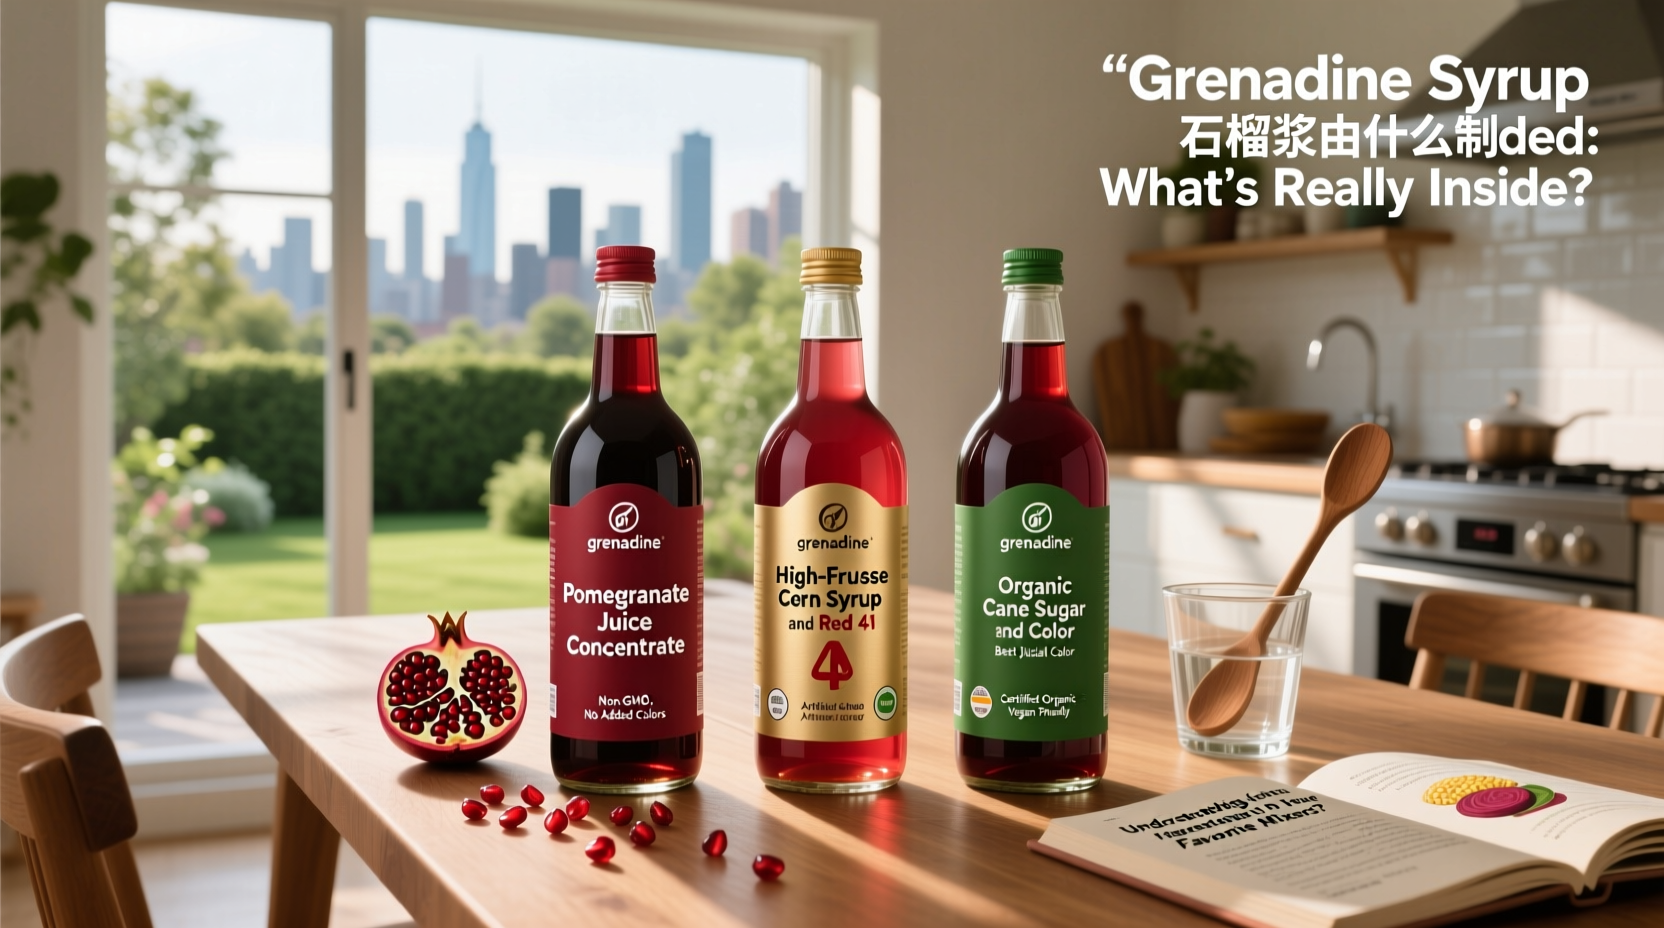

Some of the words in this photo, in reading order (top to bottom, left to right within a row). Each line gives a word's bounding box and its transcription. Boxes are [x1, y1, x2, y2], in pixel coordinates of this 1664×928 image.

[587, 534, 661, 553] grenadine
[797, 534, 870, 552] grenadine
[1000, 534, 1072, 553] grenadine
[776, 565, 889, 590] High-Frusse
[998, 575, 1073, 601] Organic
[563, 582, 690, 610] Pomegranate
[826, 589, 882, 613] Syrup
[982, 597, 1030, 618] Cane
[1034, 599, 1086, 622] Sugar
[597, 611, 653, 632] Juice
[788, 615, 814, 631] and
[819, 613, 853, 631] Red
[995, 621, 1024, 639] and
[1028, 621, 1075, 639] Color
[566, 634, 685, 657] Concentrate
[584, 708, 599, 720] No
